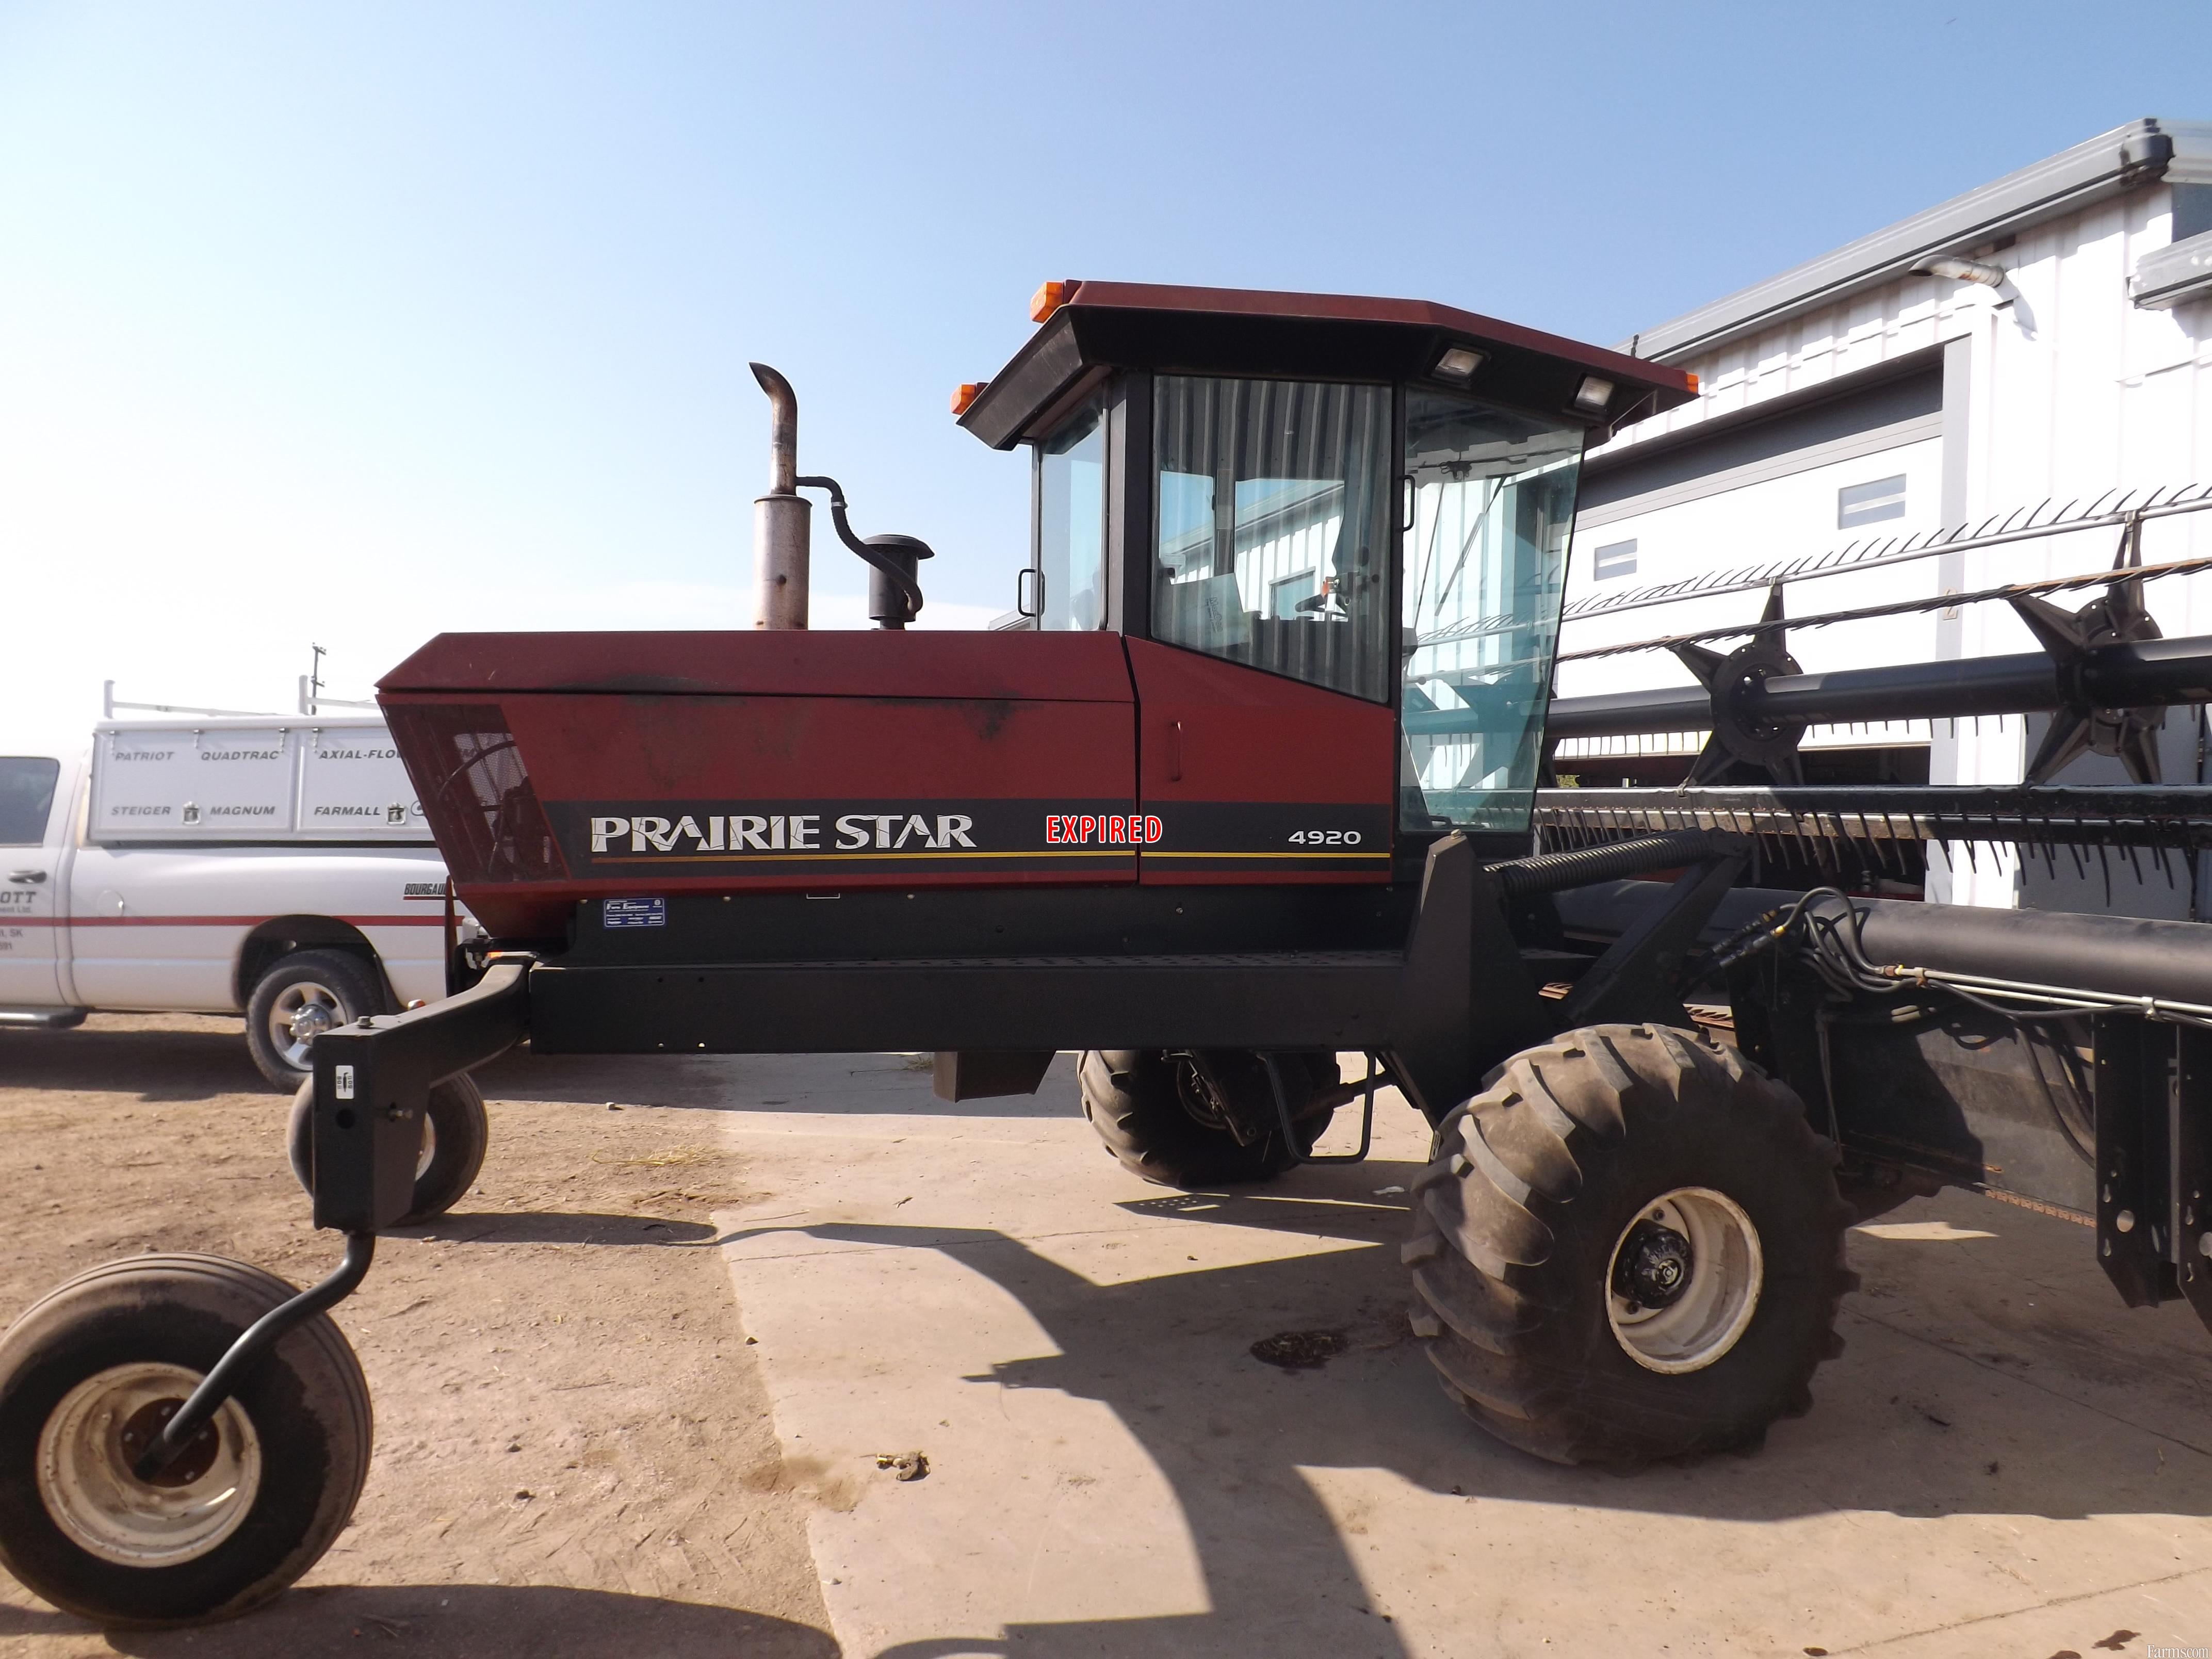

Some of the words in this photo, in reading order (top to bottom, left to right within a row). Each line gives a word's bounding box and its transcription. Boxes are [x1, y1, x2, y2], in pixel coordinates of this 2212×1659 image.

[115, 751, 174, 761] PATRIOT
[201, 751, 279, 760] QUADTRAC
[111, 806, 171, 816] STEIGER
[209, 806, 275, 815] MAGNUM
[314, 806, 381, 816] FARMALL
[591, 815, 820, 852] PRAIRIE
[835, 815, 978, 849] STAR
[1288, 830, 1362, 845] 4920
[404, 883, 446, 895] BOURGAU
